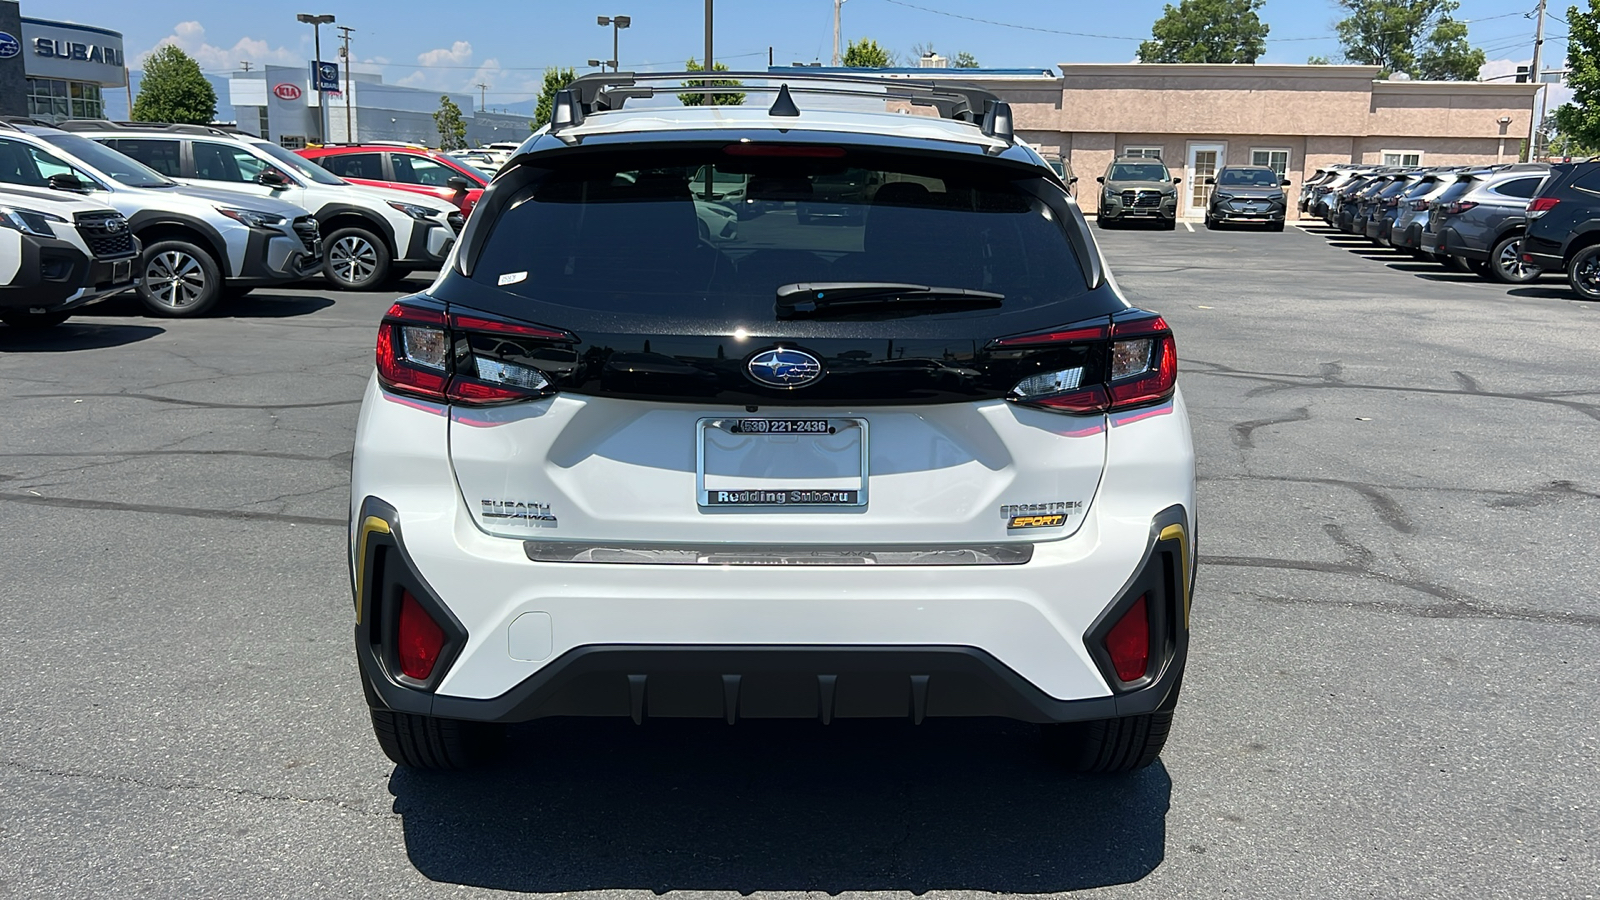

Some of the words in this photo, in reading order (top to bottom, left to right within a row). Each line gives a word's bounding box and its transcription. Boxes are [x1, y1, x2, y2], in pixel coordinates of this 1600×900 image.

[33, 37, 123, 67] SUBARU
[278, 87, 298, 98] KIA
[740, 420, 769, 433] (530)
[771, 421, 826, 432] 221-2436
[718, 491, 786, 504] Redding
[790, 491, 848, 502] Subaru
[481, 499, 550, 509] SUBARU
[1000, 501, 1083, 512] CROSSTREK
[1012, 515, 1062, 527] SPORT
